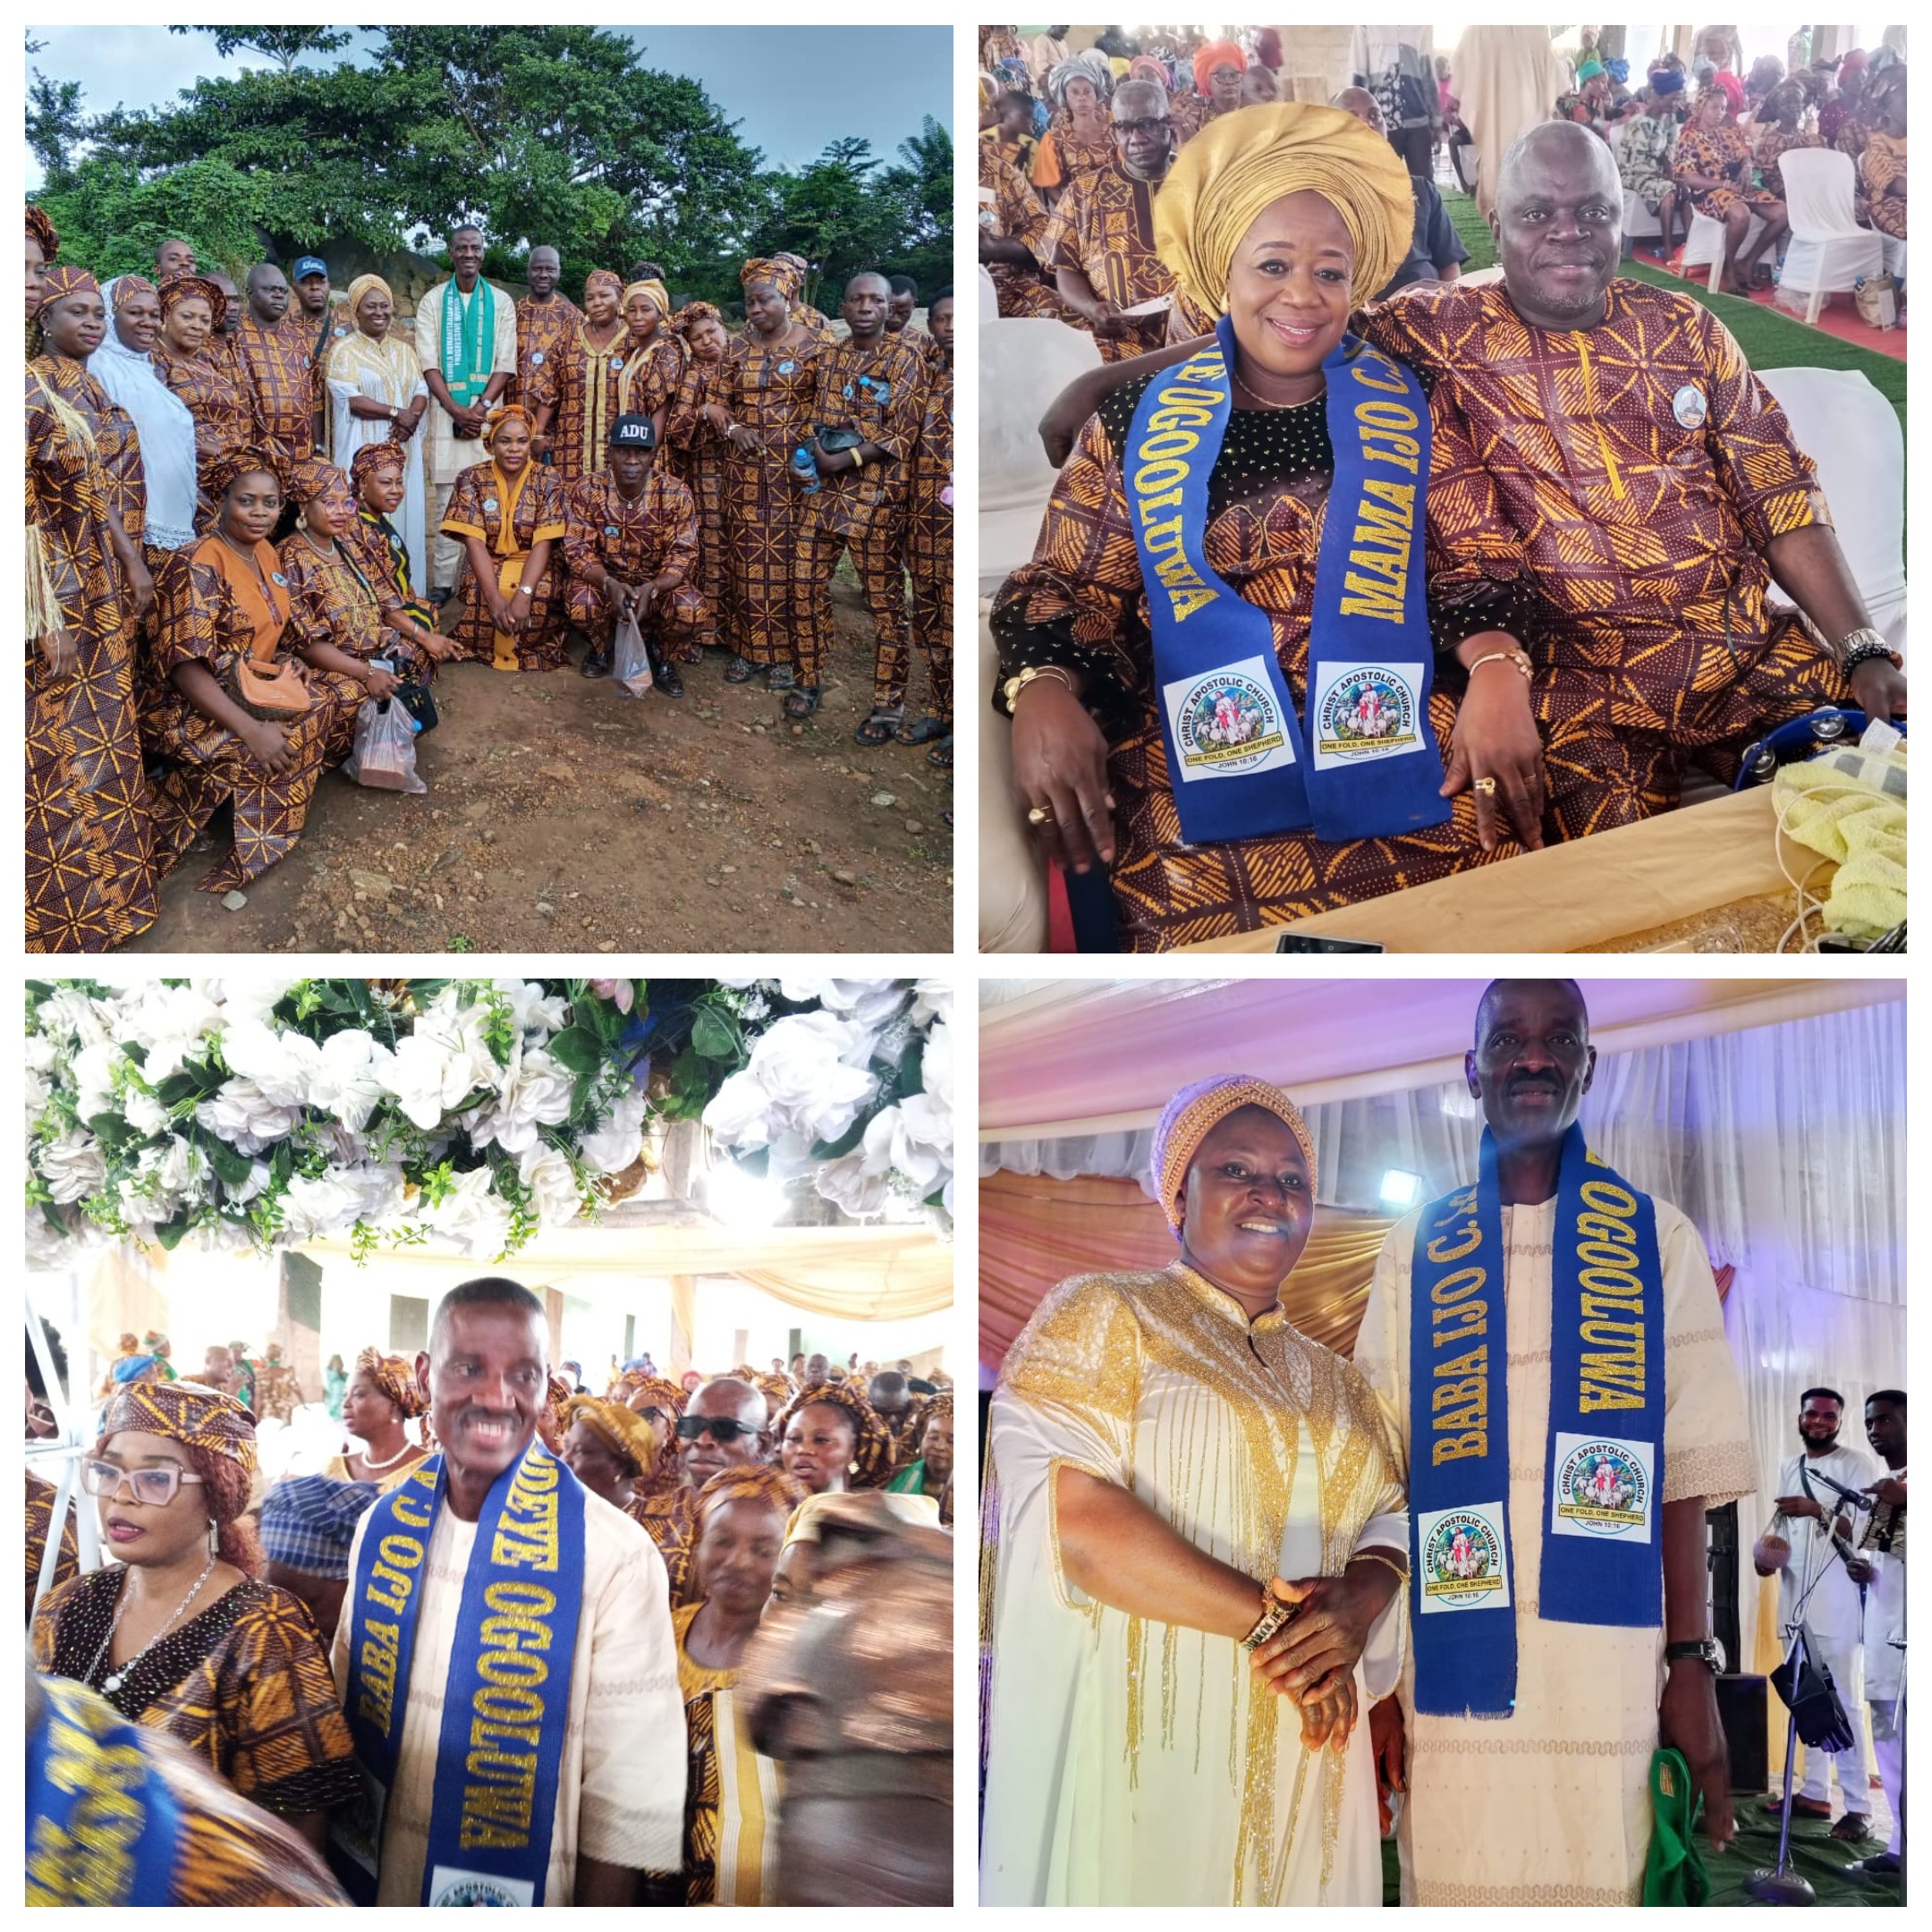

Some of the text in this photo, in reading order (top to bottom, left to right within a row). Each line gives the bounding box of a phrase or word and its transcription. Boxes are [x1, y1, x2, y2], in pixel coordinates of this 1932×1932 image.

[620, 424, 648, 439] ADU
[1354, 402, 1420, 475] IJO
[1133, 387, 1225, 623] OGOOLUWA
[1340, 479, 1417, 623] MAMA
[1182, 677, 1274, 747] CHRIST APOSTOLIC CHURCH
[1323, 672, 1411, 730] CHRIST APOSTOLIC CHURCH
[1204, 753, 1225, 761] FOLD,
[1227, 748, 1242, 757] ONE
[1244, 735, 1281, 751] SHEPHERD
[1218, 760, 1237, 768] JOHN
[1377, 736, 1415, 745] SHEPHERD
[1431, 1267, 1488, 1348] IJO
[1576, 1181, 1645, 1413] OGOOLUWA
[1432, 1343, 1488, 1467] BABA
[1563, 1445, 1645, 1504] CHRIST APOSTOLIC CHURCH
[1427, 1515, 1498, 1573] CHRIST APOSTOLIC CHURCH
[1611, 1512, 1644, 1521] SHEPHERD
[366, 1534, 425, 1615] IJO
[1470, 1579, 1500, 1587] SHEPHERD
[360, 1618, 399, 1738] BABA
[459, 1580, 556, 1851] OGOOLUWA
